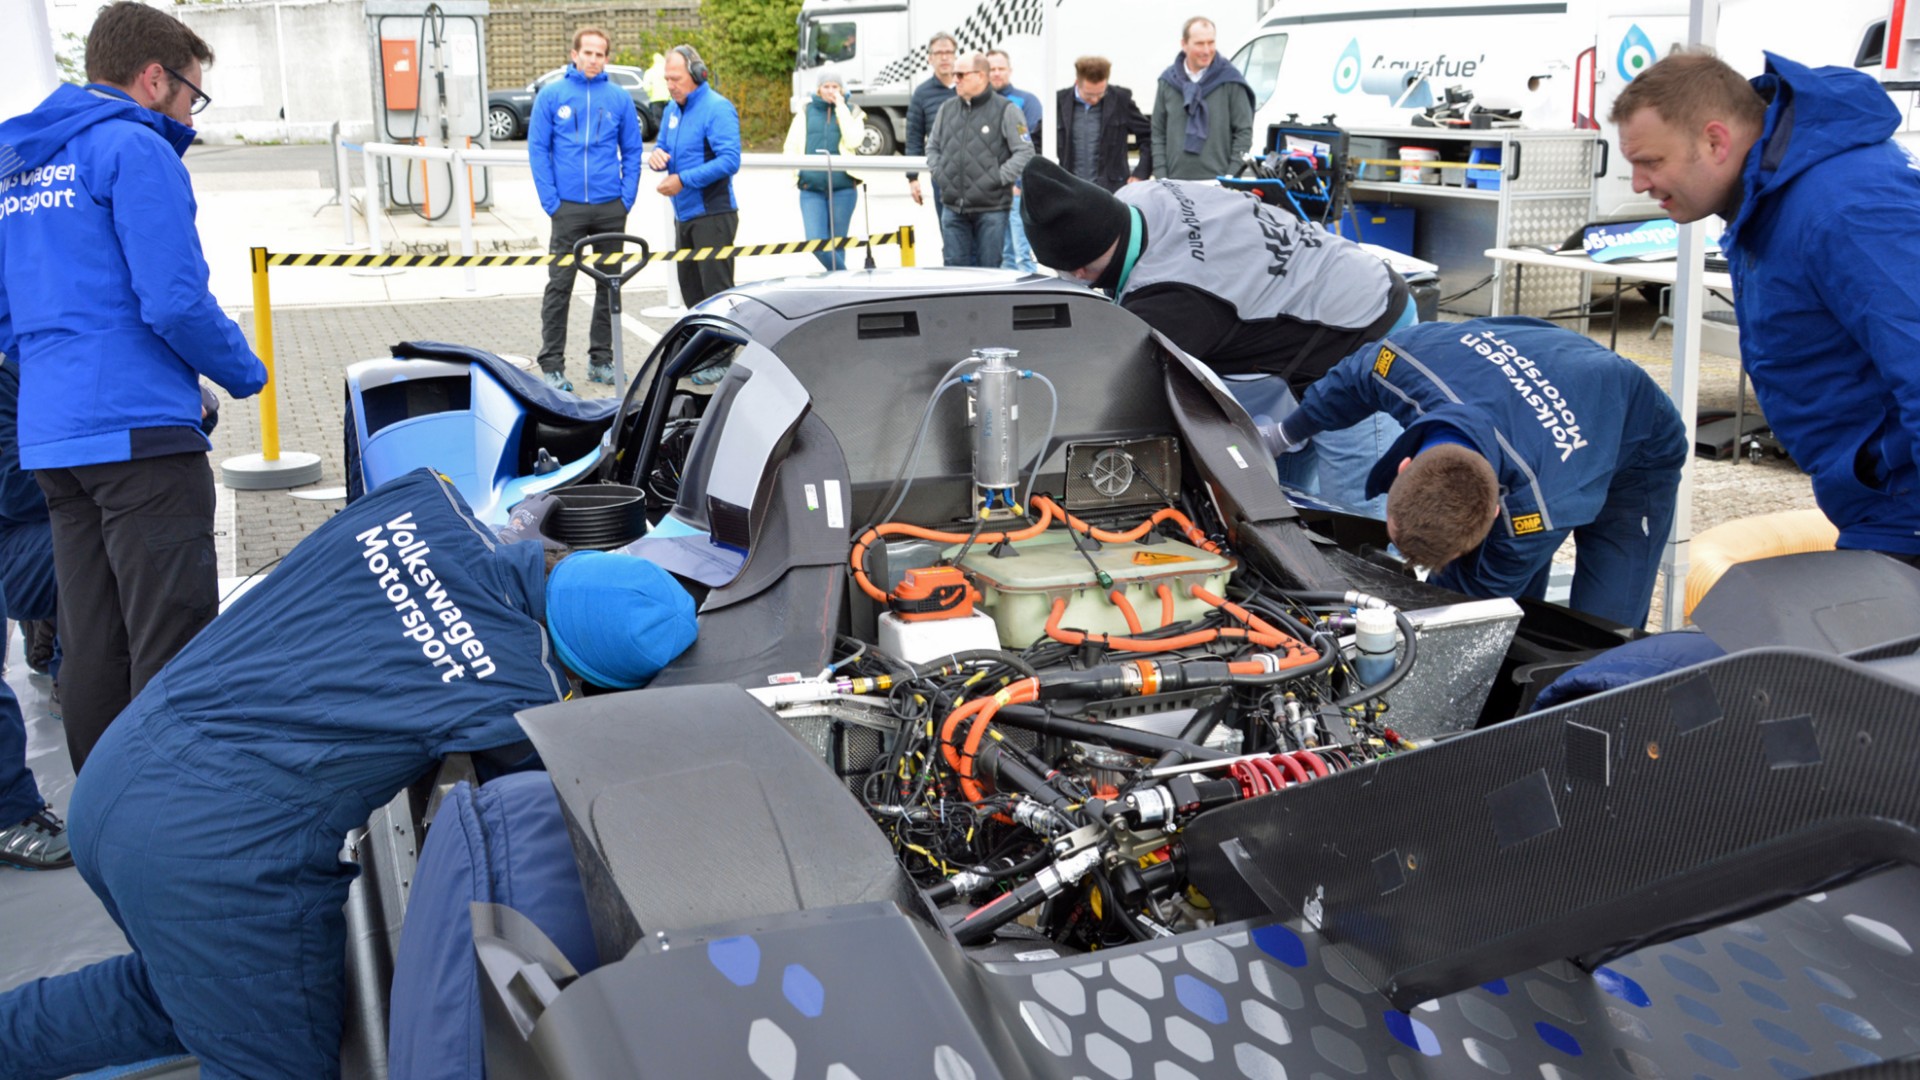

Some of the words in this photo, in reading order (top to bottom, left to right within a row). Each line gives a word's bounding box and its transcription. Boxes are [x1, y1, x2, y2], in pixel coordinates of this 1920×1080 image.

[1371, 54, 1485, 78] Auafue
[1459, 333, 1574, 462] Volkswagen
[1480, 330, 1588, 449] Motorsport
[1514, 517, 1541, 531] OMP
[355, 525, 466, 683] Motorsport
[386, 511, 496, 679] Volkswagen
